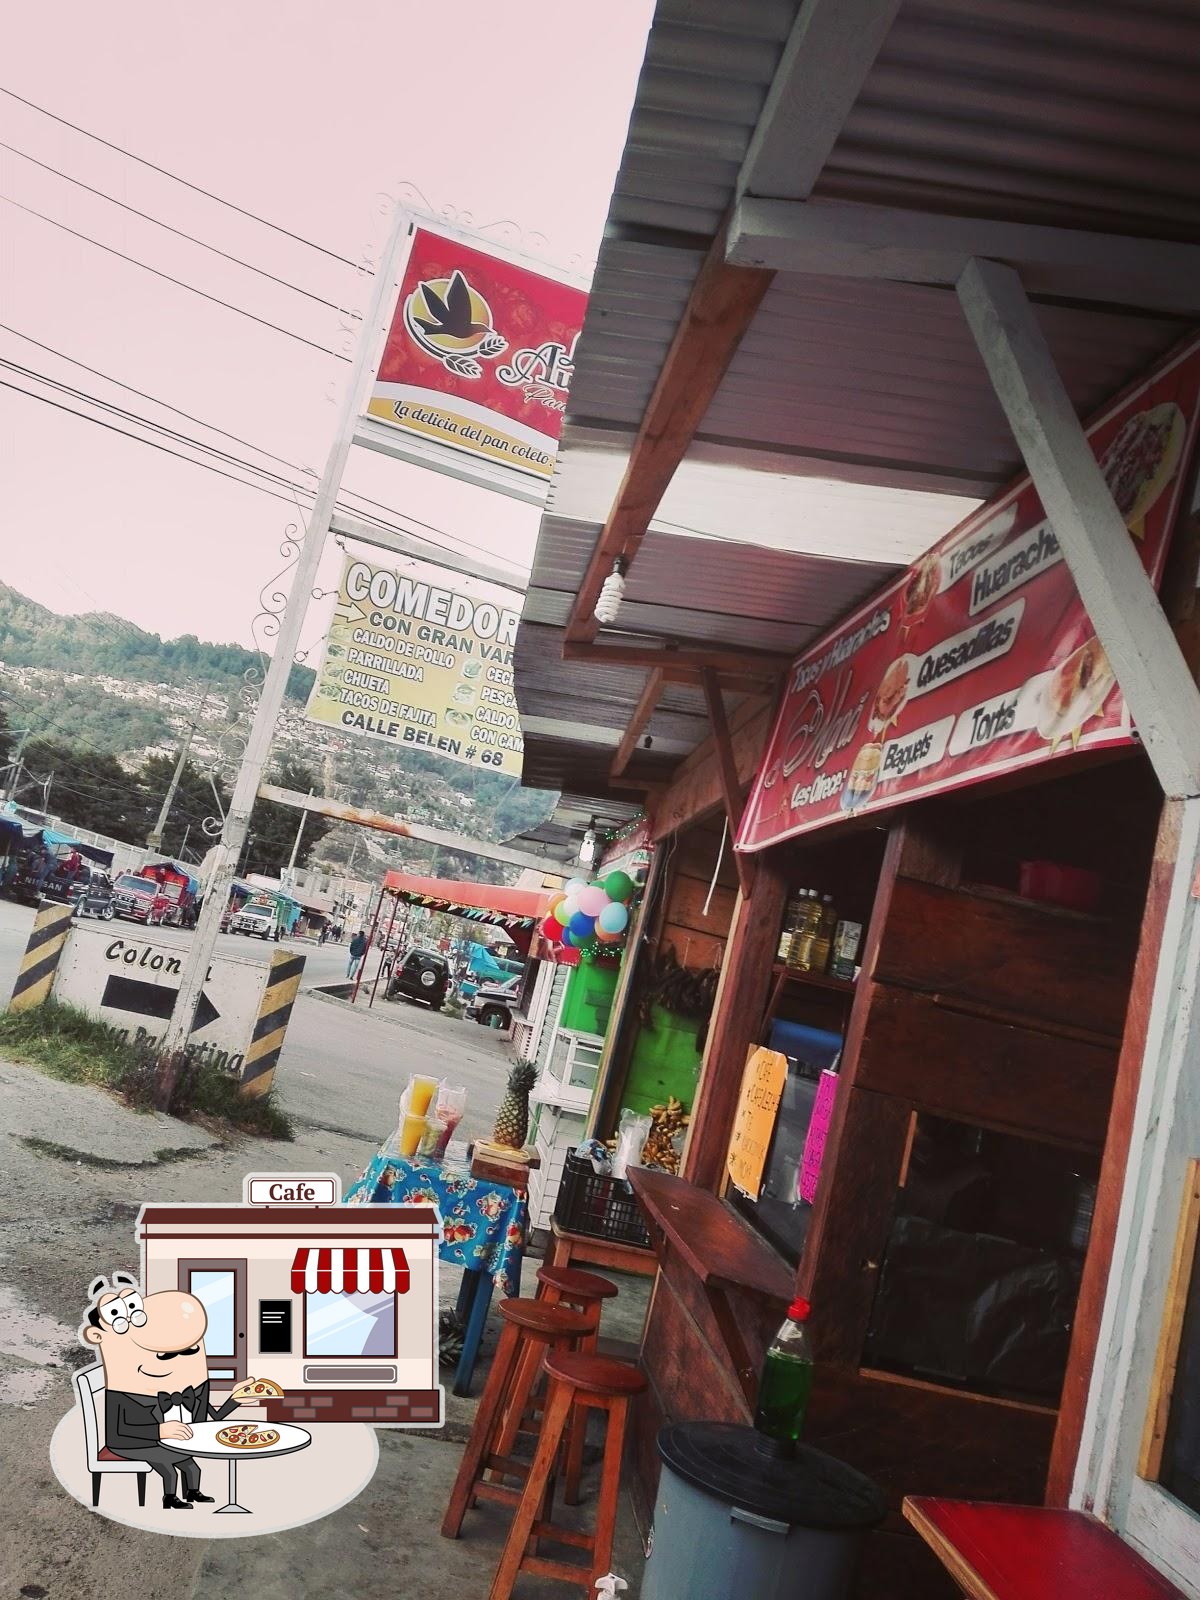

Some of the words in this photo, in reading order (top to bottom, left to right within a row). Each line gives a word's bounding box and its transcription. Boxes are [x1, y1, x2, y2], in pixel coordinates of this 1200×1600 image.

[393, 400, 408, 419] La
[411, 406, 457, 433] delicia
[460, 424, 482, 442] del
[480, 433, 509, 452] pan
[346, 561, 521, 647] COMEDOR
[353, 628, 394, 651] CALDO
[396, 638, 414, 657] DE
[413, 646, 456, 669] POLLO
[369, 611, 413, 636] CON
[417, 625, 474, 654] GRAN
[343, 669, 391, 695] CHUETA
[347, 648, 424, 682] PARRILLADA
[339, 687, 379, 711] TACOS
[380, 697, 398, 716] DE
[399, 704, 438, 728] FAJITA
[475, 706, 515, 729] CALDO
[341, 710, 400, 738] CALLE
[402, 726, 462, 755] BELEN
[465, 744, 477, 759] #
[480, 749, 504, 767] 68
[470, 726, 498, 745] CON
